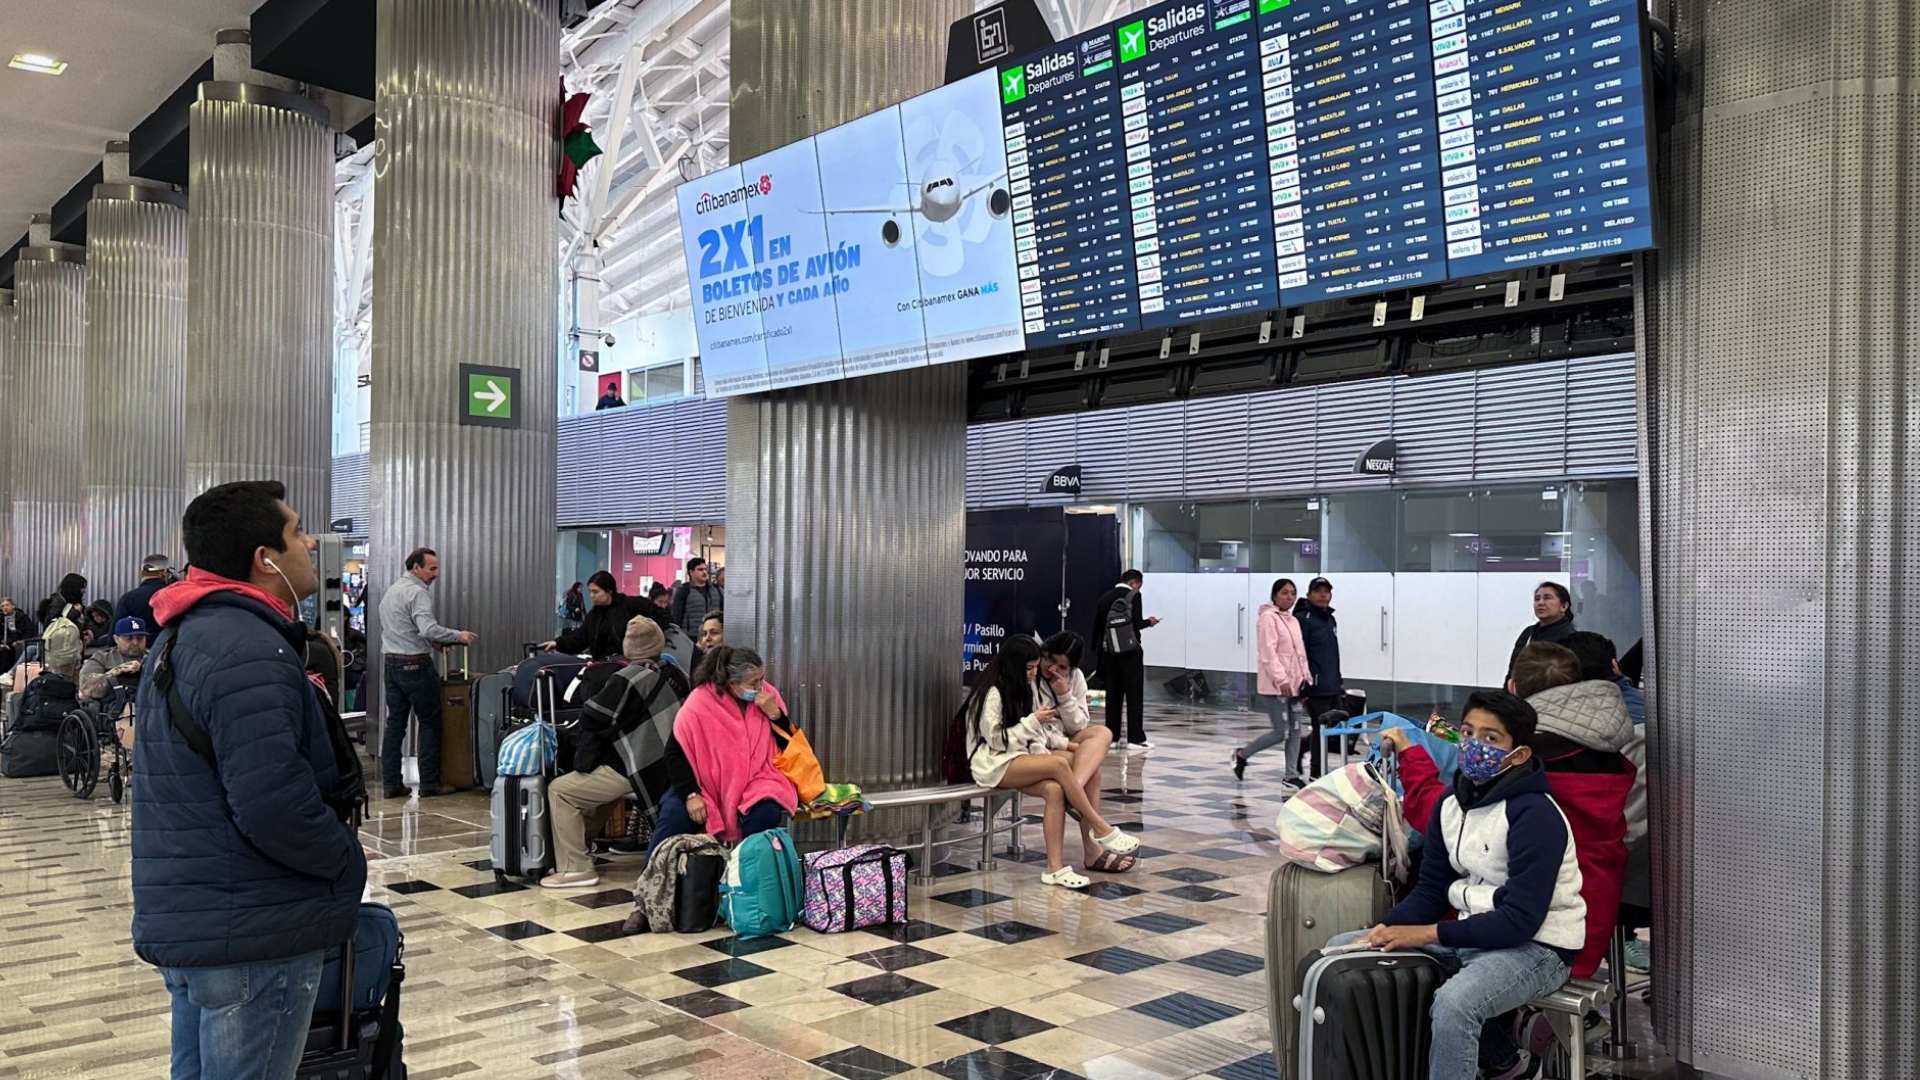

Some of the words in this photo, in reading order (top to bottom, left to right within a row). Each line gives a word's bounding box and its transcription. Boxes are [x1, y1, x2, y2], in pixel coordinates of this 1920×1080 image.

[1322, 5, 1330, 13] TO
[1148, 2, 1205, 36] Salidas
[1398, 17, 1410, 27] TIME
[1150, 24, 1205, 52] Departures
[1399, 33, 1412, 43] TIME
[1498, 39, 1534, 54] S.SALVADOR
[1590, 14, 1620, 29] ARRIVED
[1592, 34, 1621, 48] ARRIVED
[1401, 52, 1413, 60] TIME
[1026, 51, 1075, 80] Salidas
[1402, 72, 1415, 81] TIME
[1500, 77, 1538, 92] HERMOSILLO
[1593, 60, 1603, 68] ON
[1604, 55, 1619, 65] TIME
[1028, 71, 1075, 95] Departures
[1403, 90, 1416, 98] TIME
[1502, 102, 1524, 112] DALLAS
[1594, 82, 1604, 90] ON
[1605, 78, 1621, 88] TIME
[1503, 115, 1542, 129] GUADALAJARA
[1595, 99, 1606, 108] ON
[1607, 95, 1622, 105] TIME
[1320, 129, 1339, 138] MERIDA
[1405, 108, 1417, 116] TIME
[1397, 127, 1422, 139] DELAYED
[1505, 135, 1540, 148] MONTERREY
[1597, 119, 1607, 127] ON
[1608, 115, 1623, 125] TIME
[1233, 134, 1254, 145] DELAYED
[1598, 141, 1609, 149] ON
[1610, 137, 1624, 147] TIME
[1408, 143, 1420, 152] TIME
[1409, 162, 1421, 170] TIME
[1507, 177, 1532, 187] CANCUN
[1611, 158, 1626, 167] TIME
[1410, 181, 1423, 189] TIME
[1509, 196, 1533, 206] CANCUN
[1612, 177, 1627, 186] TIME
[696, 182, 760, 214] citibanamex
[1412, 199, 1424, 208] TIME
[1510, 212, 1549, 224] GUADALAJARA
[1613, 196, 1628, 205] TIME
[1413, 217, 1425, 225] TIME
[1511, 231, 1548, 243] GUATEMALA
[1604, 216, 1634, 227] DELAYED
[698, 214, 764, 280] 2X1
[769, 234, 792, 260] EN
[1504, 253, 1527, 262] viernes
[1541, 244, 1575, 256] diciembre
[1580, 241, 1596, 250] 2023
[1602, 237, 1621, 247] 11:19
[702, 268, 773, 304] BOLETOS
[778, 261, 800, 286] DE
[806, 240, 860, 280] AVIÓN
[1325, 284, 1344, 293] viernes
[1355, 277, 1383, 288] diciembre
[1387, 274, 1401, 282] 2023
[1406, 271, 1421, 279] 11:19
[705, 309, 717, 324] DE
[719, 296, 775, 321] BIENVENIDA
[776, 294, 785, 308] Y
[788, 285, 819, 305] CADA
[823, 274, 850, 297] AÑO
[897, 302, 910, 312] Con
[912, 293, 956, 310] Citibanamex
[957, 286, 980, 300] GANA
[980, 281, 999, 294] MÁS
[1366, 457, 1394, 471] NESCAFÉ
[1053, 475, 1080, 487] BBVA
[964, 550, 1000, 562] OVANDO
[1003, 550, 1028, 562] PARA
[964, 568, 980, 580] JOR
[982, 568, 1024, 580] SERVICIO
[975, 624, 1005, 637] Pasillo
[964, 642, 992, 654] rminal
[996, 643, 1000, 654] 1
[962, 659, 971, 672] ja
[973, 659, 989, 671] Pu
